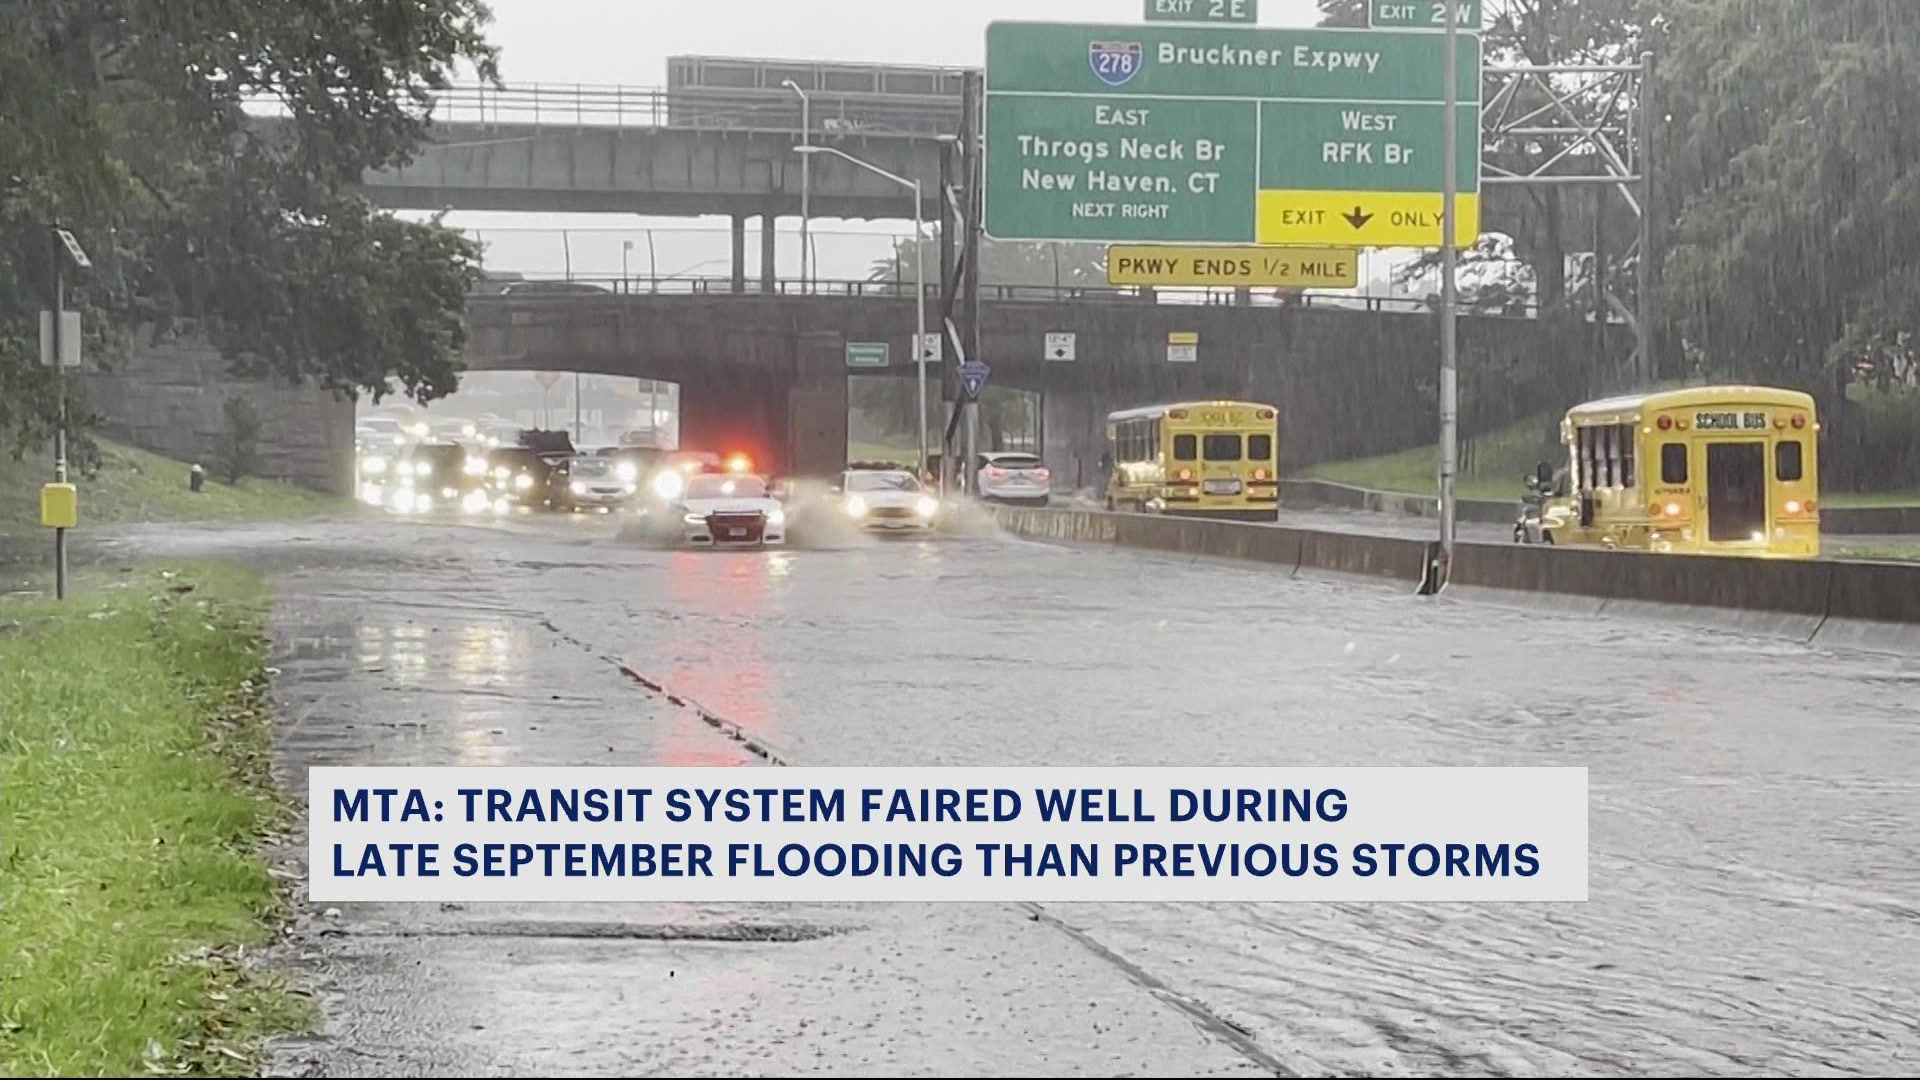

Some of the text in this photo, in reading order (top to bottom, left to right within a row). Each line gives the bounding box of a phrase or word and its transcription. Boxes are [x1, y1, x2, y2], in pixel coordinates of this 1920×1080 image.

[1155, 0, 1193, 13] EXIT
[1379, 5, 1417, 20] EXIT
[1099, 53, 1133, 74] 278
[1158, 43, 1380, 72] Bruckner Expwy
[1095, 105, 1150, 127] EAST
[1341, 110, 1398, 132] WEST
[1018, 136, 1225, 163] Throgs Neck Br
[1322, 143, 1414, 165] RFK Br
[1021, 168, 1077, 191] New
[1188, 173, 1220, 194] CT
[1072, 203, 1170, 220] NEXT RIGHT
[1282, 210, 1446, 227] EXIT ONLY
[1118, 259, 1178, 275] PKWY
[1193, 260, 1252, 276] ENDS
[1300, 262, 1347, 278] MILE
[1696, 412, 1766, 430] SCHOOL BUS
